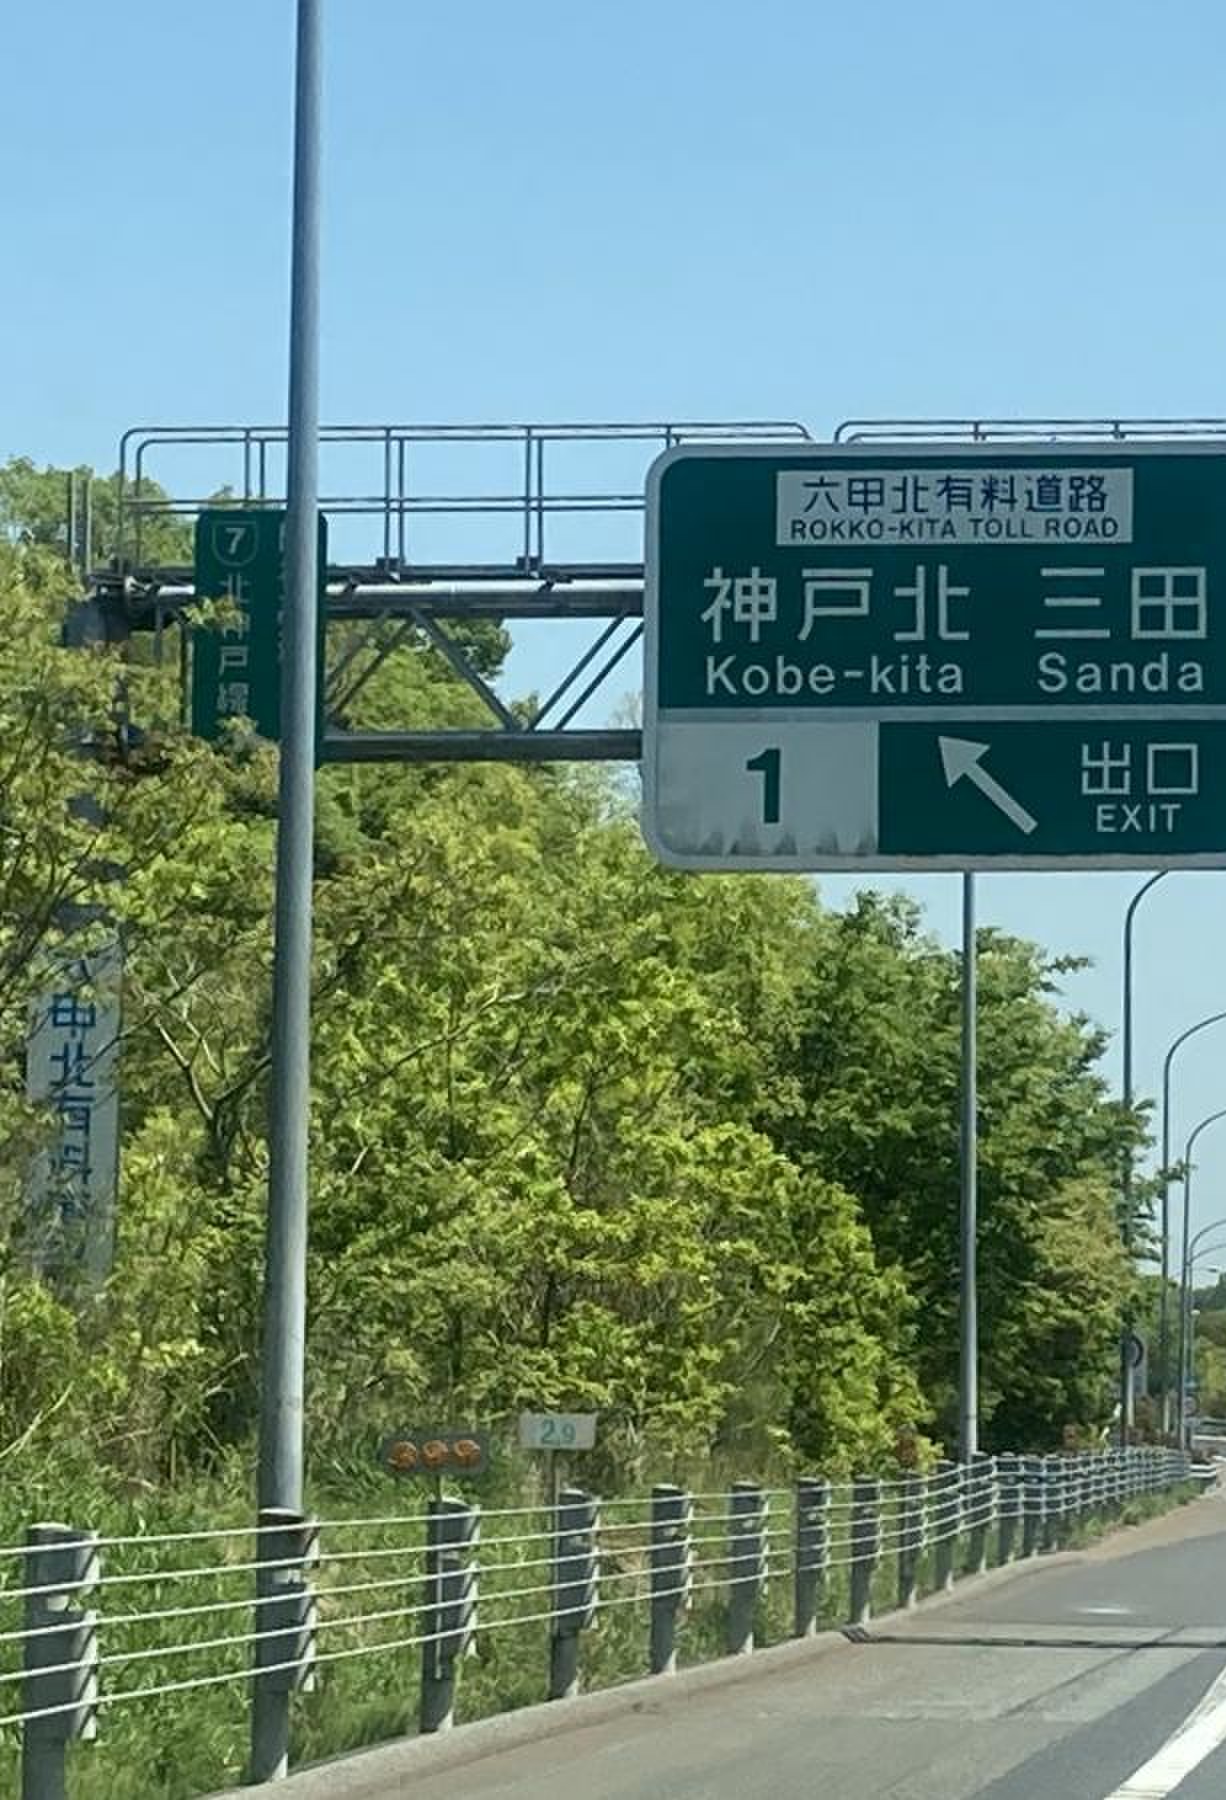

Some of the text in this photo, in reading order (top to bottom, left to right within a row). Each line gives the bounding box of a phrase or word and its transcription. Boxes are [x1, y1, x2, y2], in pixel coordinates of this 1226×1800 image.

[802, 474, 1109, 514] 六甲北有料道路
[225, 527, 246, 554] 7
[790, 516, 1119, 540] ROKKO-KITA TOLL ROAD
[700, 564, 1207, 643] 神戸北 三田
[707, 652, 1204, 695] Kobe-kita Sanda
[746, 748, 781, 824] 1
[1081, 741, 1199, 795] 出口
[1096, 803, 1181, 833] EXIT
